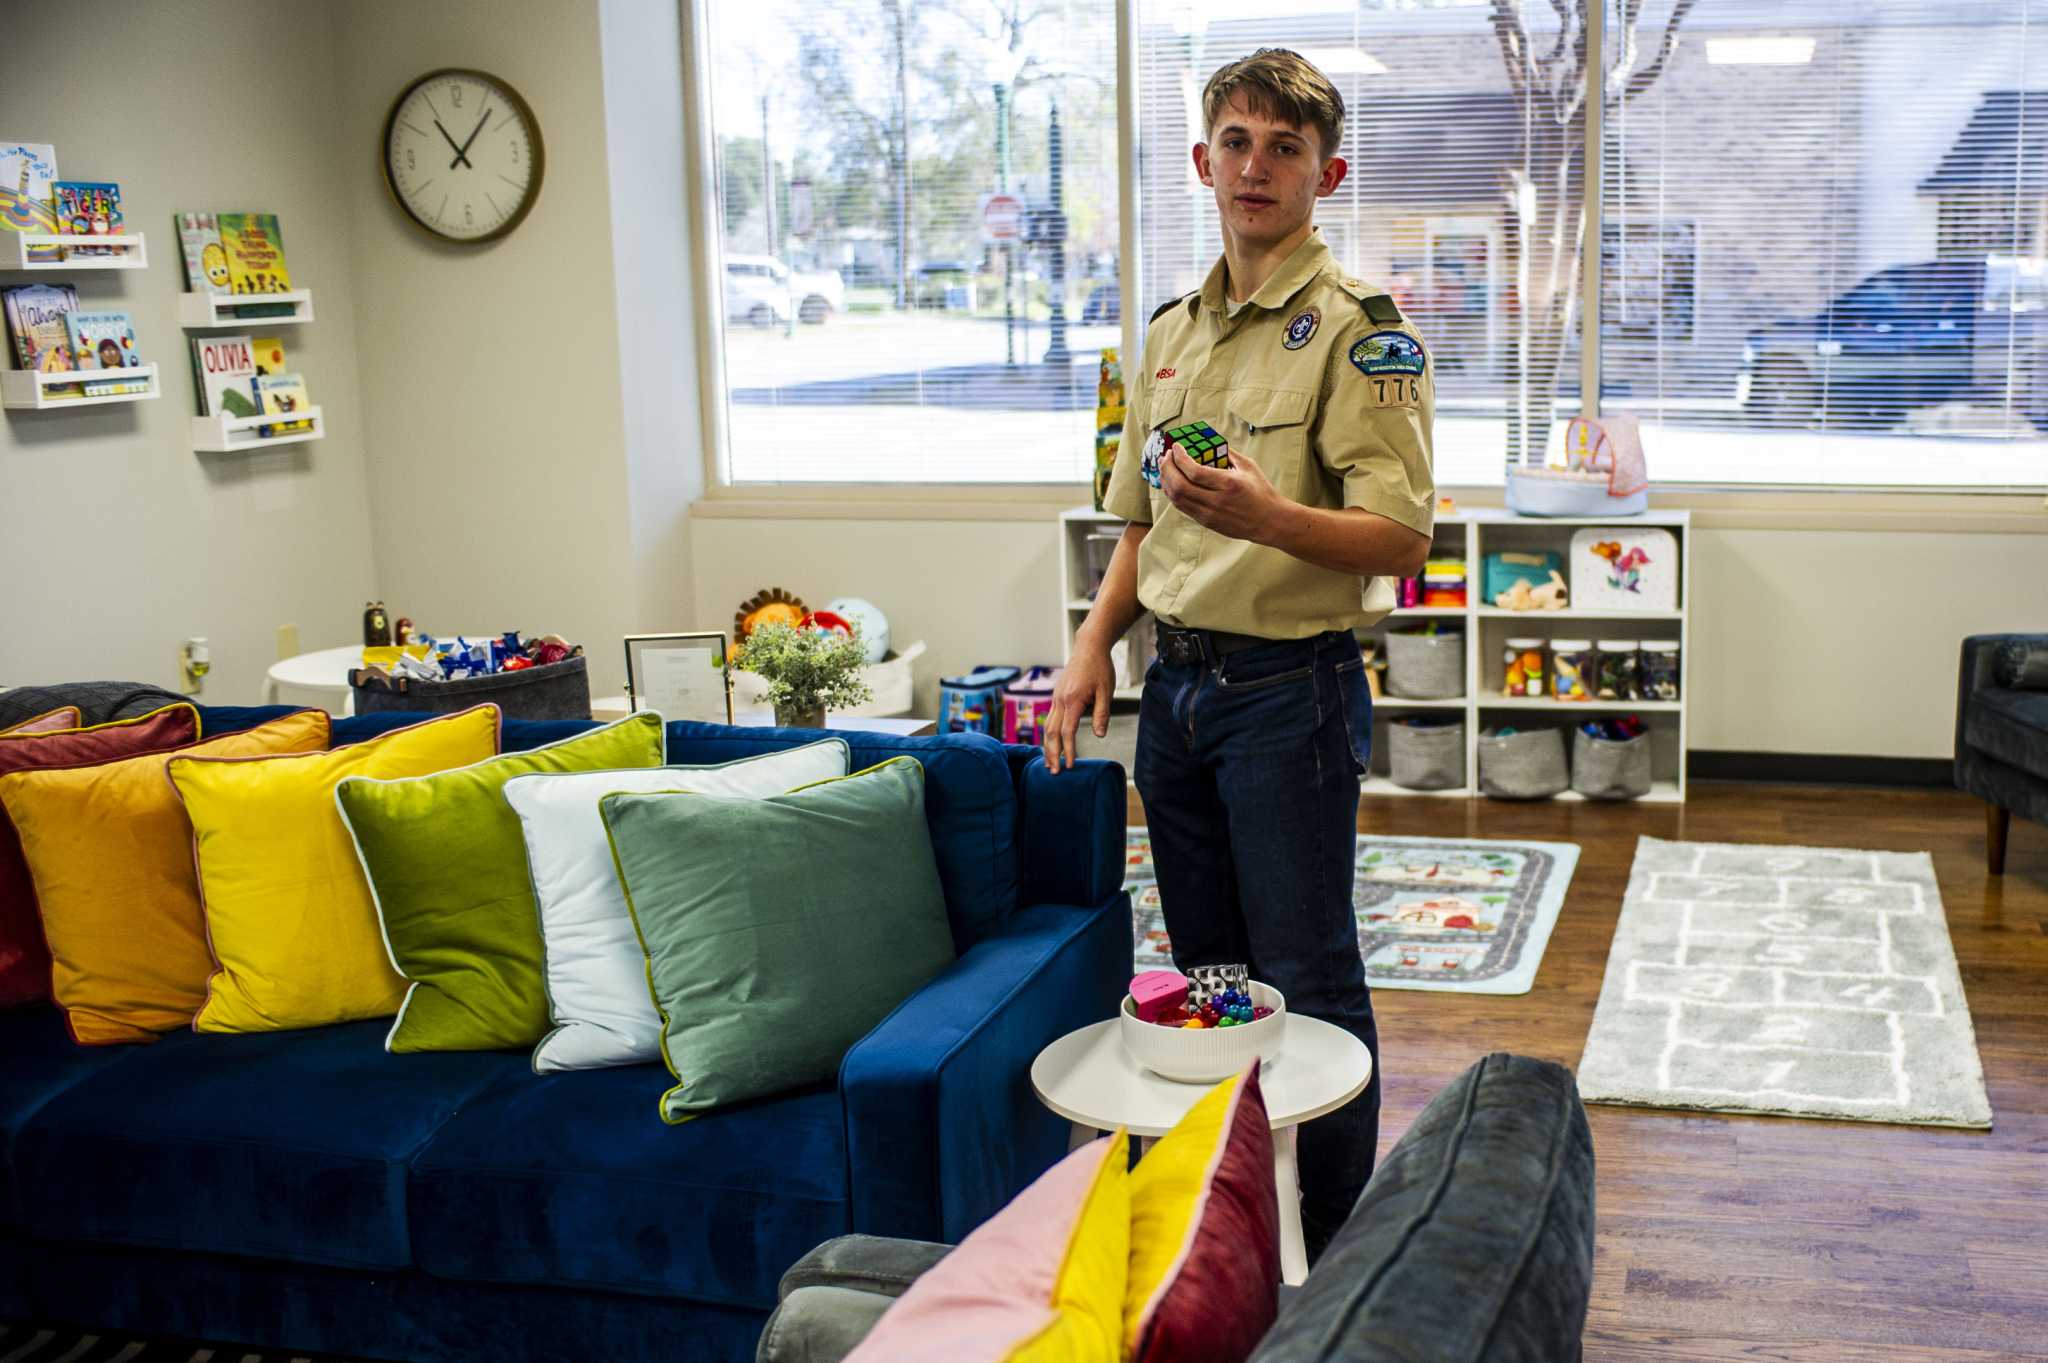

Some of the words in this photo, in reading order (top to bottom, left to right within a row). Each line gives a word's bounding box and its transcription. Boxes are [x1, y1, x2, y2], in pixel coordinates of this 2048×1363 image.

[204, 343, 252, 373] OLIVIA
[1160, 367, 1176, 379] BSA
[1373, 378, 1418, 402] 776
